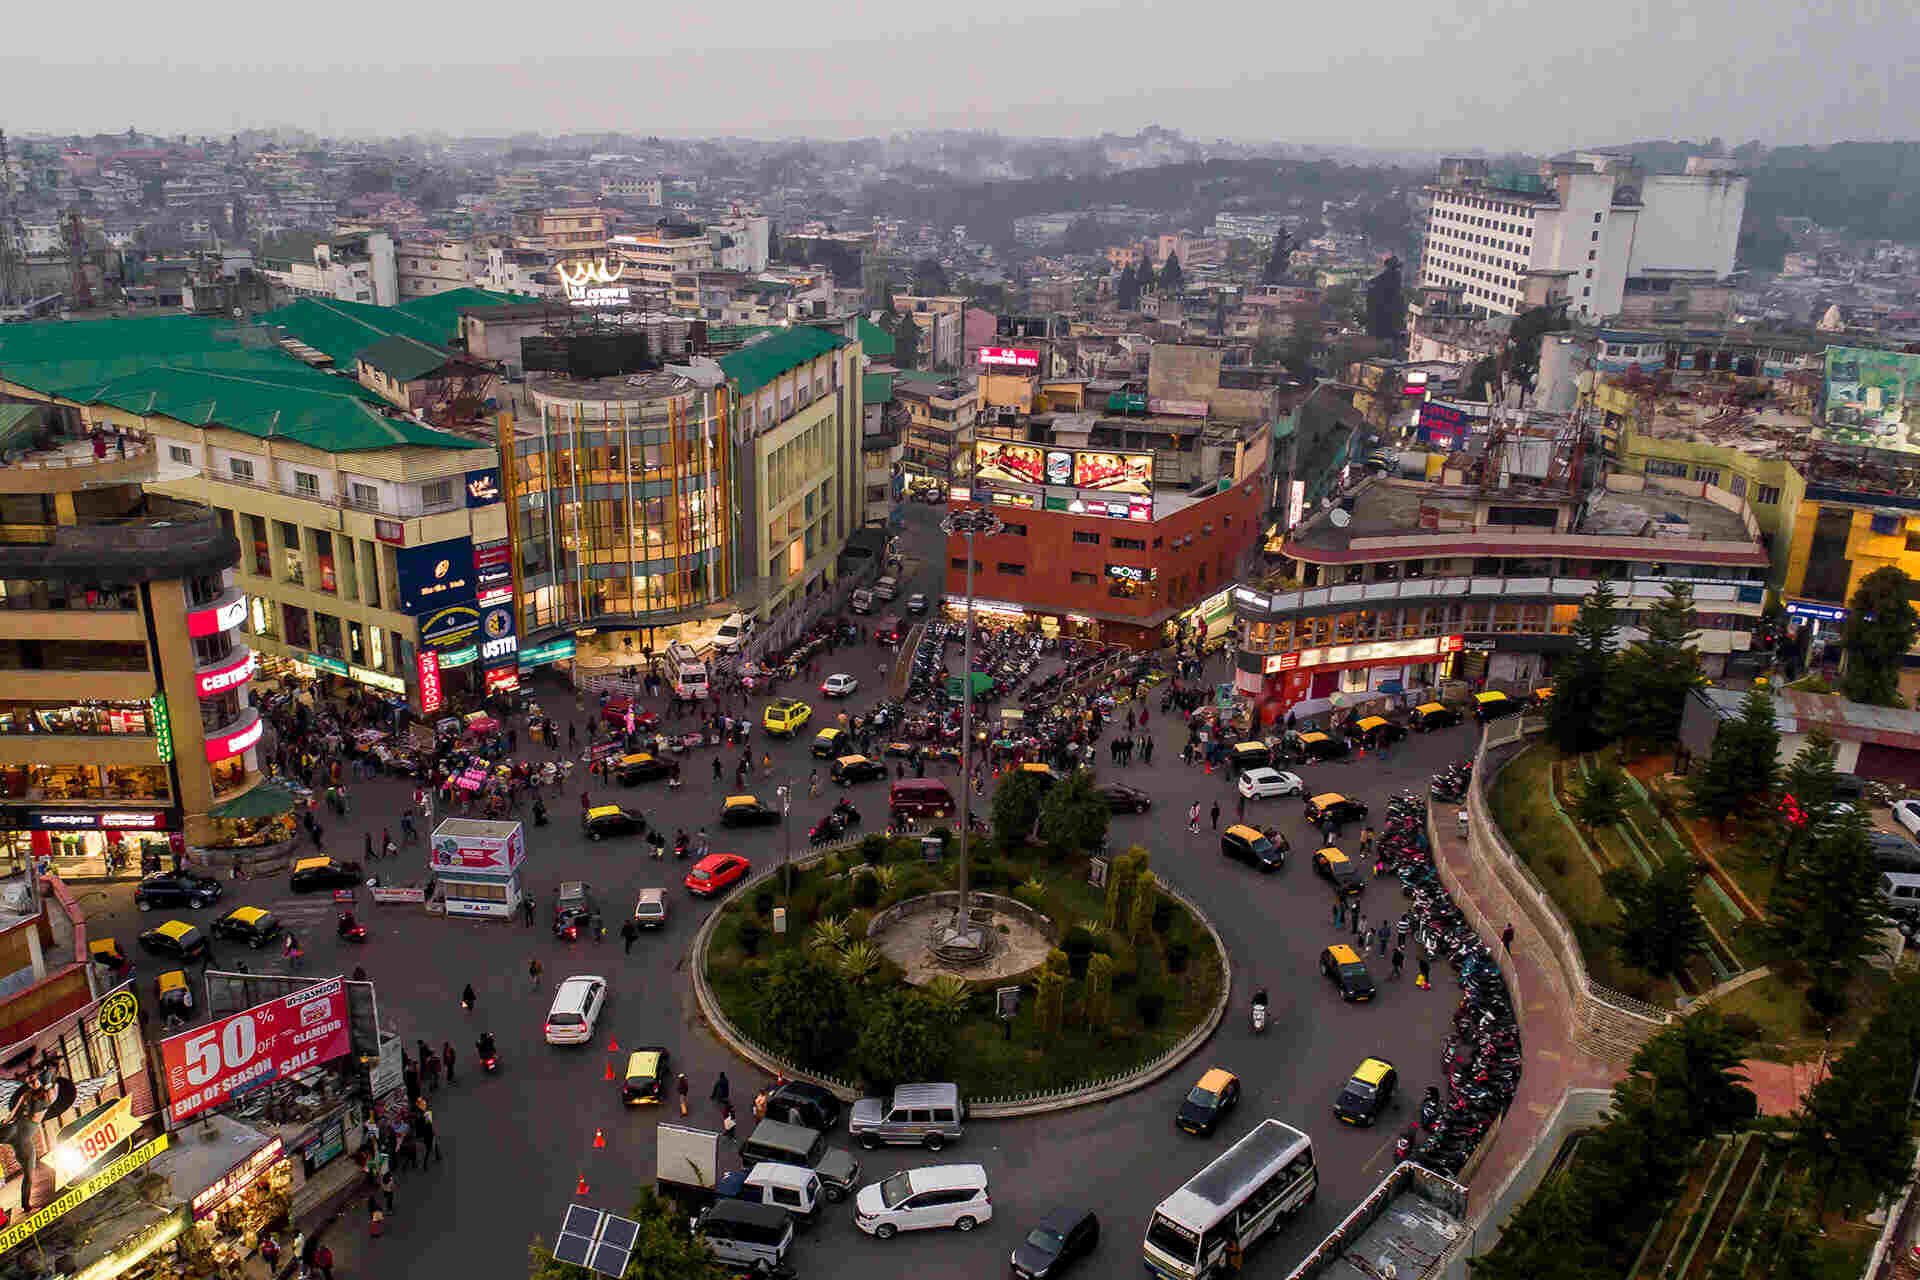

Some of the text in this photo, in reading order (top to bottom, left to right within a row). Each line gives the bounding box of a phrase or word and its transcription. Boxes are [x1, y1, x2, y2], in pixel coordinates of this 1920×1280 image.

[257, 1034, 277, 1054] OFF
[175, 1093, 201, 1116] END
[203, 1084, 221, 1101] OF
[222, 1058, 273, 1092] SEASON
[279, 1046, 319, 1076] SALE
